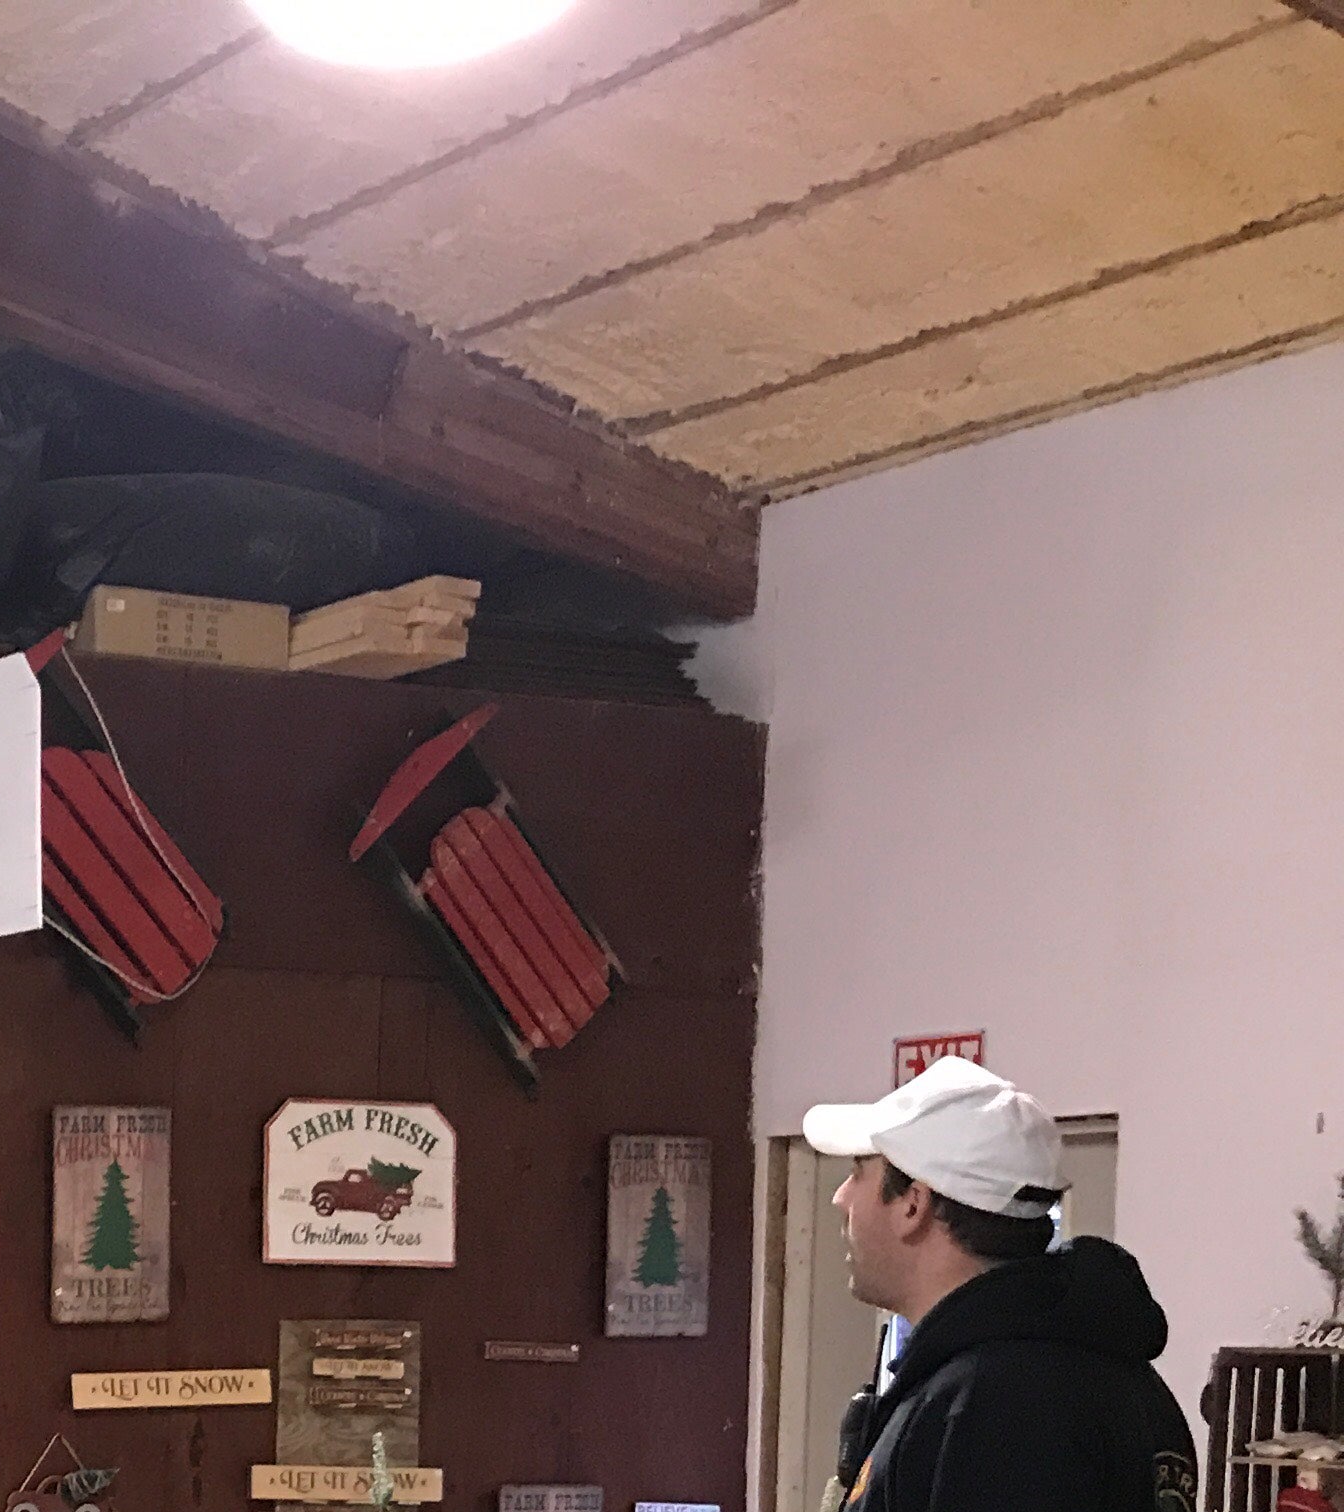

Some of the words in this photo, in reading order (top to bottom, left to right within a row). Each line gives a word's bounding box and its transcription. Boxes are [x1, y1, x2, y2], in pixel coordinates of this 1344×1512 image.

[60, 1114, 106, 1134] FARM
[287, 1107, 355, 1151] FARM
[365, 1108, 440, 1157] FRESH
[291, 1222, 369, 1246] Christmas
[375, 1222, 421, 1246] Trees
[102, 1376, 143, 1400] LET
[146, 1375, 171, 1395] IT
[179, 1375, 244, 1400] SNOW
[280, 1470, 320, 1493] LET
[324, 1470, 348, 1489] IT
